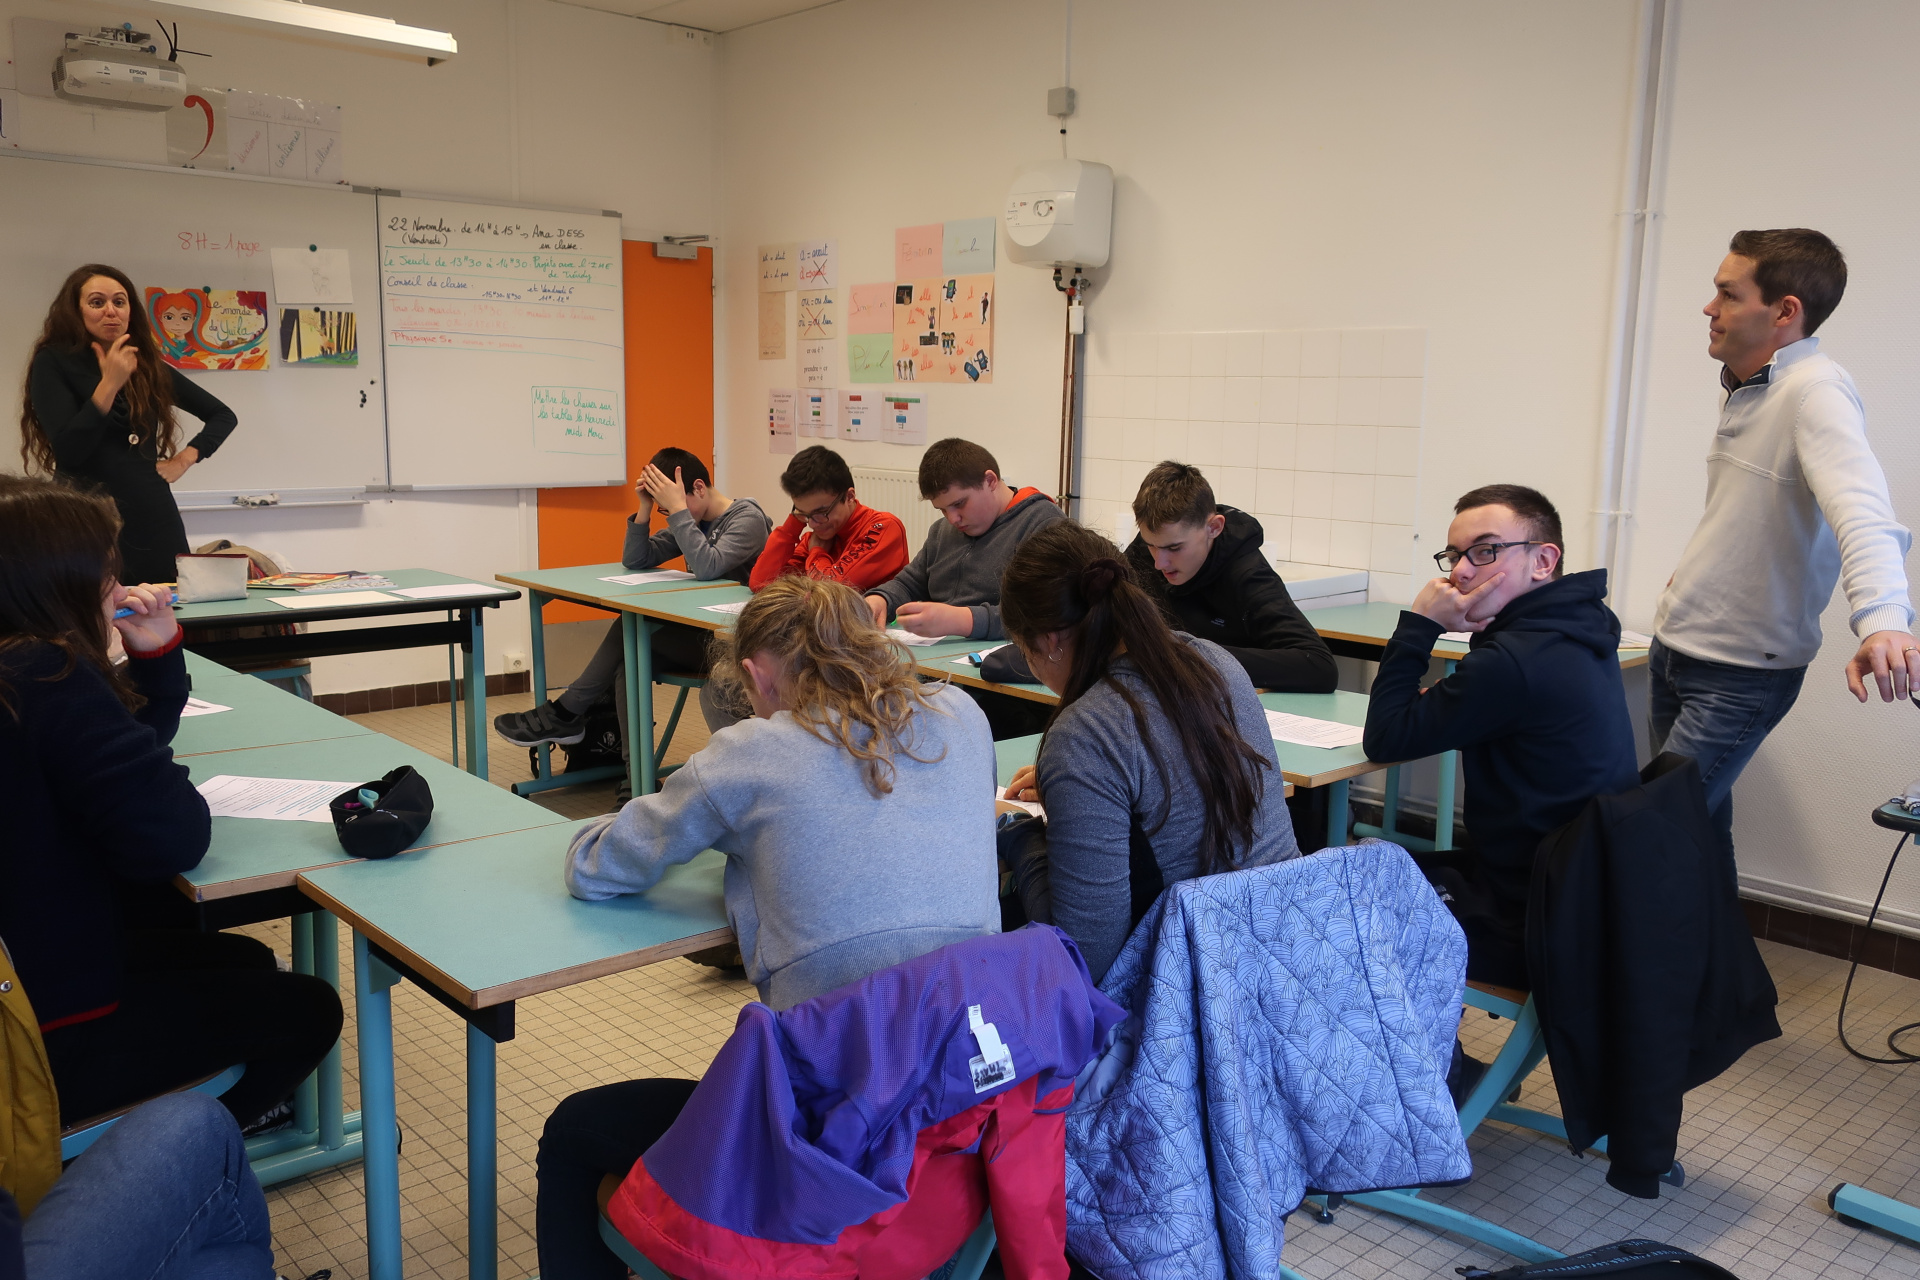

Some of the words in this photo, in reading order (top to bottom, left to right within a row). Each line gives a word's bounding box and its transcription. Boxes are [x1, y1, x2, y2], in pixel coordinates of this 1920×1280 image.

[129, 68, 148, 76] EPSON
[387, 216, 408, 231] 22
[460, 221, 472, 234] de
[492, 224, 499, 236] à
[235, 239, 264, 259] page
[539, 242, 551, 250] en
[383, 250, 395, 266] Le
[399, 253, 431, 267] Jeudi
[435, 256, 447, 267] de
[486, 257, 493, 268] à
[548, 270, 558, 279] de
[386, 275, 422, 287] Conseil
[426, 276, 437, 287] de
[220, 306, 252, 315] monde
[208, 319, 218, 332] de
